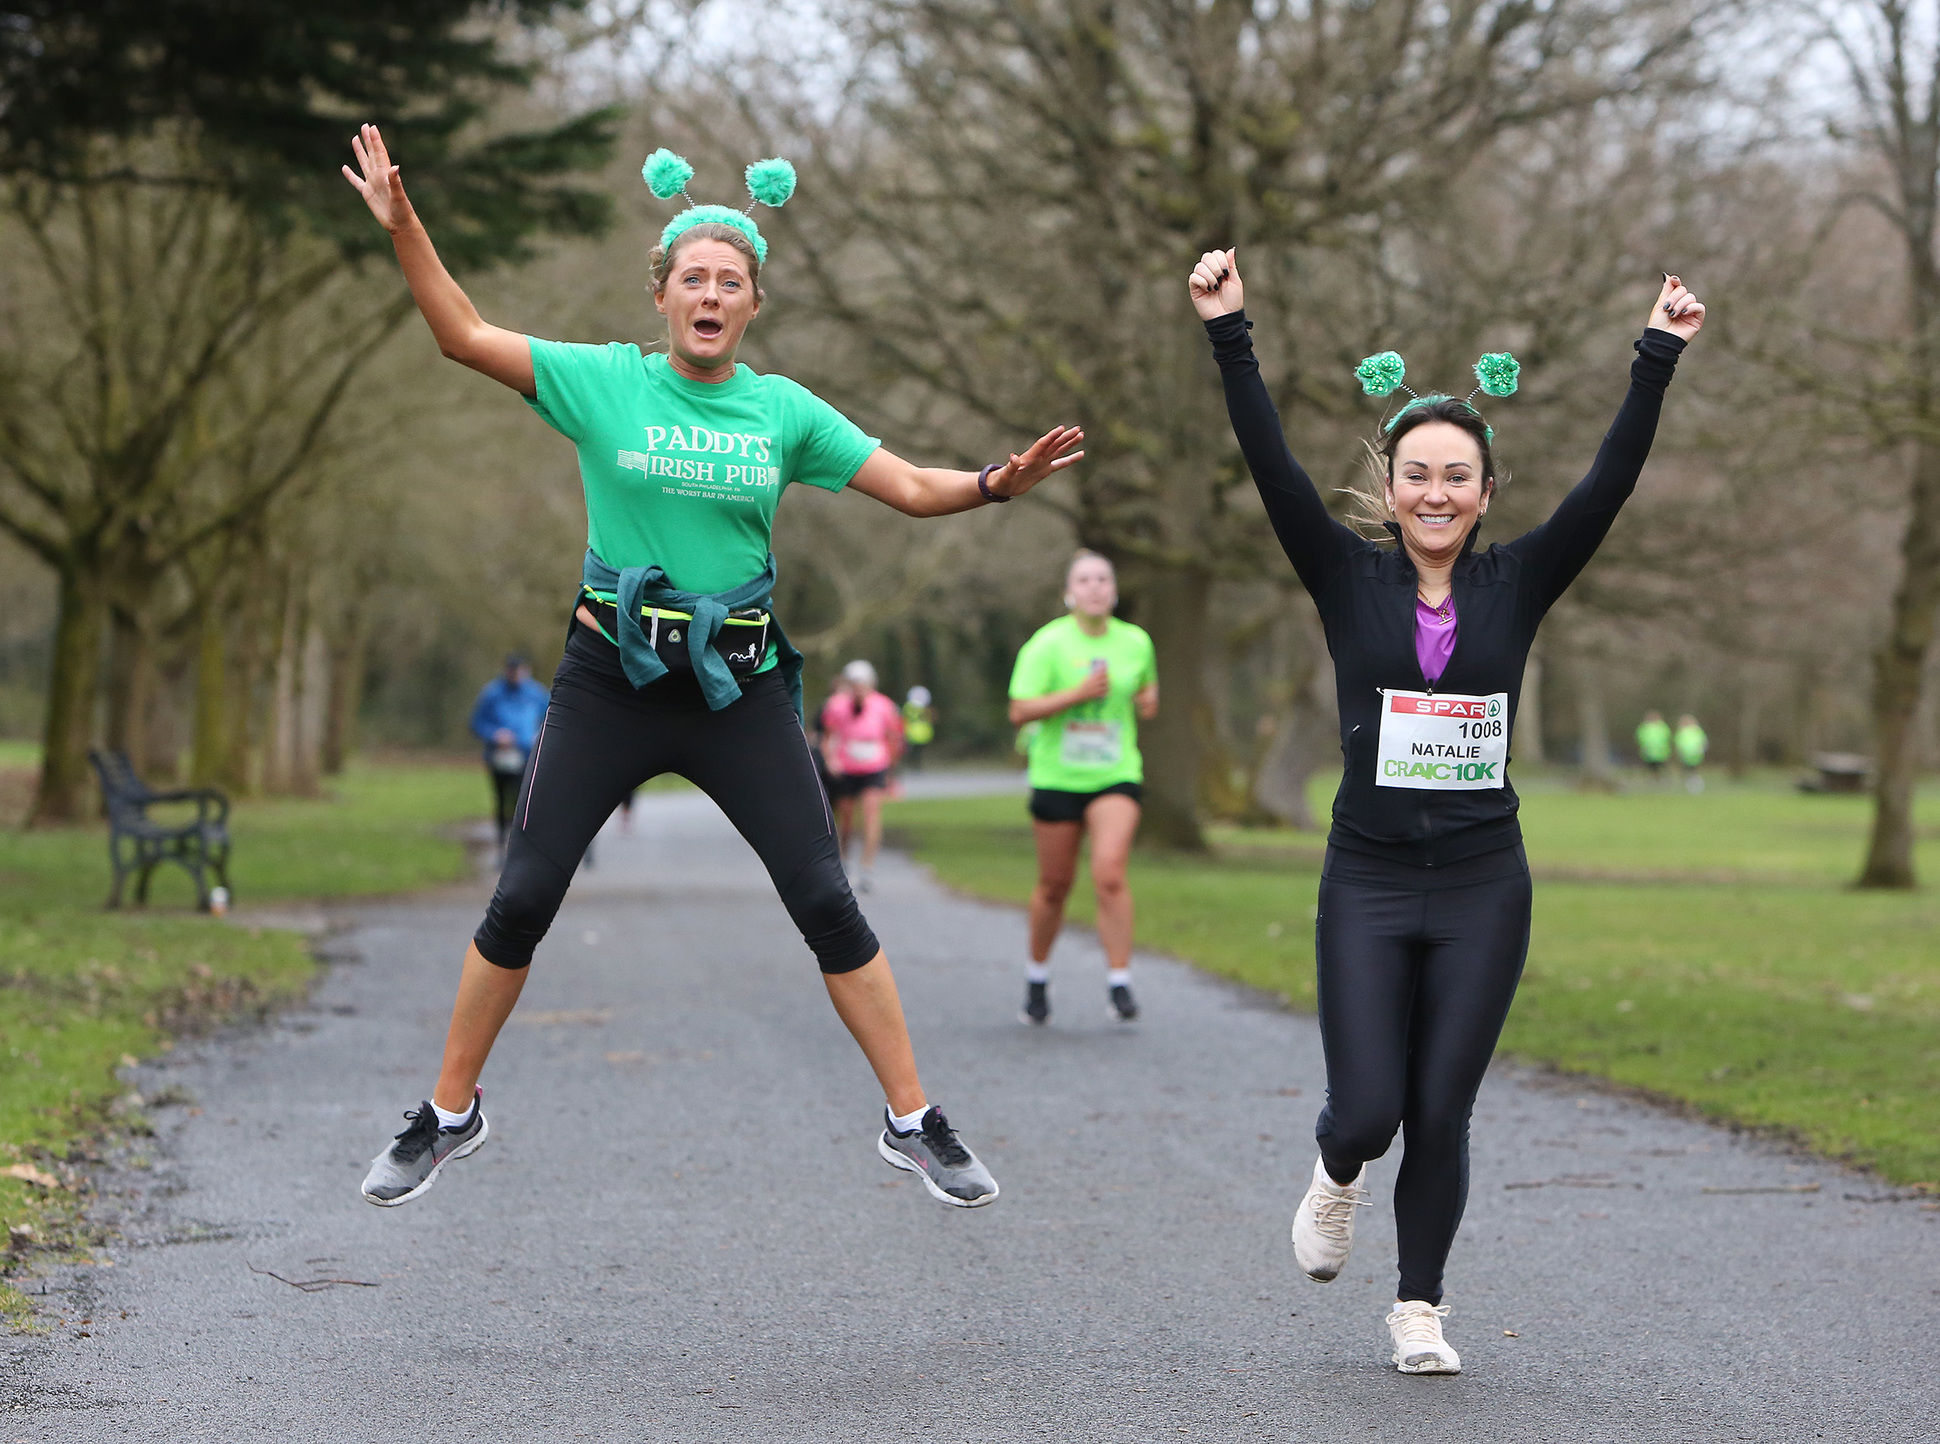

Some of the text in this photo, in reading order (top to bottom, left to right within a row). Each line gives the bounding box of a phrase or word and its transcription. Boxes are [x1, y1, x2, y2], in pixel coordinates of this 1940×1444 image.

[644, 425, 771, 463] PADDY'S
[650, 456, 768, 486] IRISH PUB
[662, 486, 675, 494] THE
[676, 488, 701, 497] WORST
[702, 491, 716, 499] BAR
[1416, 701, 1485, 716] SPAR
[1459, 720, 1502, 739] 1008
[1412, 743, 1480, 758] NATALIE
